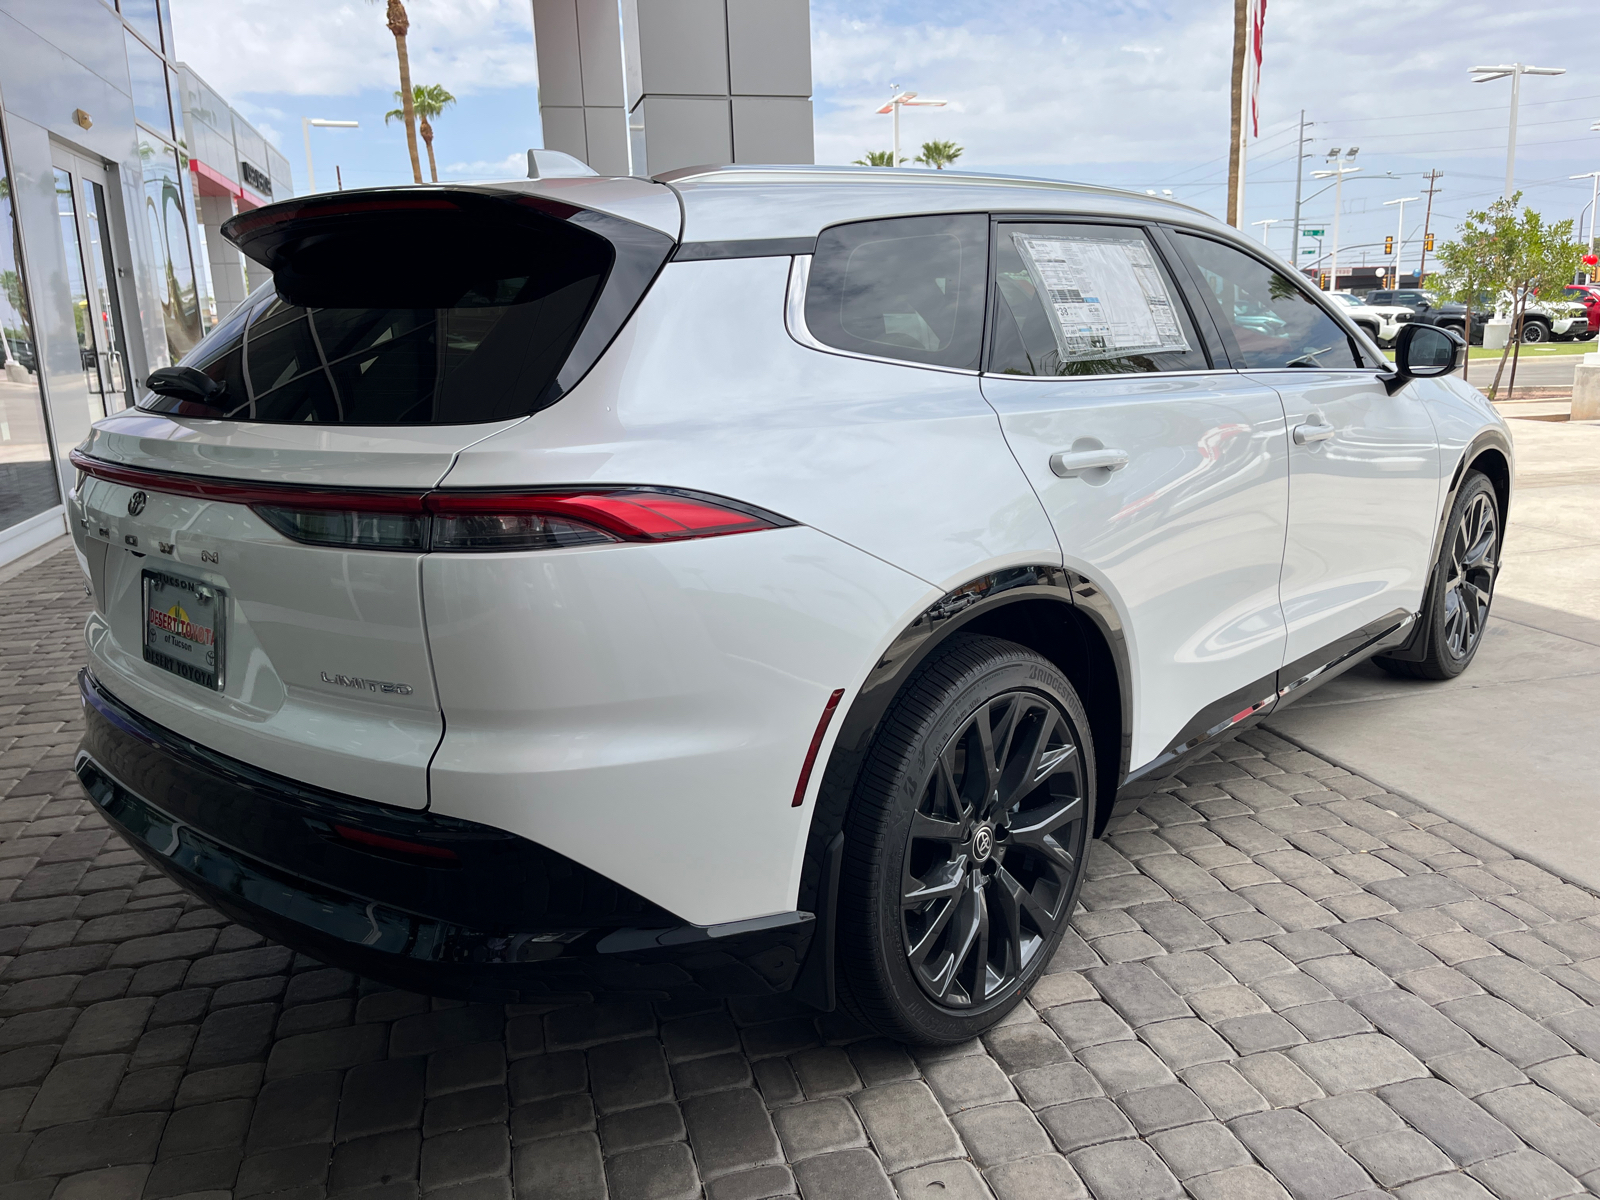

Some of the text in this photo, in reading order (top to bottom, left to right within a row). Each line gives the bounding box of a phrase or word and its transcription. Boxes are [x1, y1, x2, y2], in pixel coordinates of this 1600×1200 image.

[158, 572, 195, 592] TUCSON
[150, 608, 179, 634] DESERT
[165, 635, 193, 652] of Tucson
[146, 648, 213, 687] DESERT TOYOTA
[321, 671, 413, 695] LIMITED
[1029, 664, 1083, 722] BRIDGESTONE
